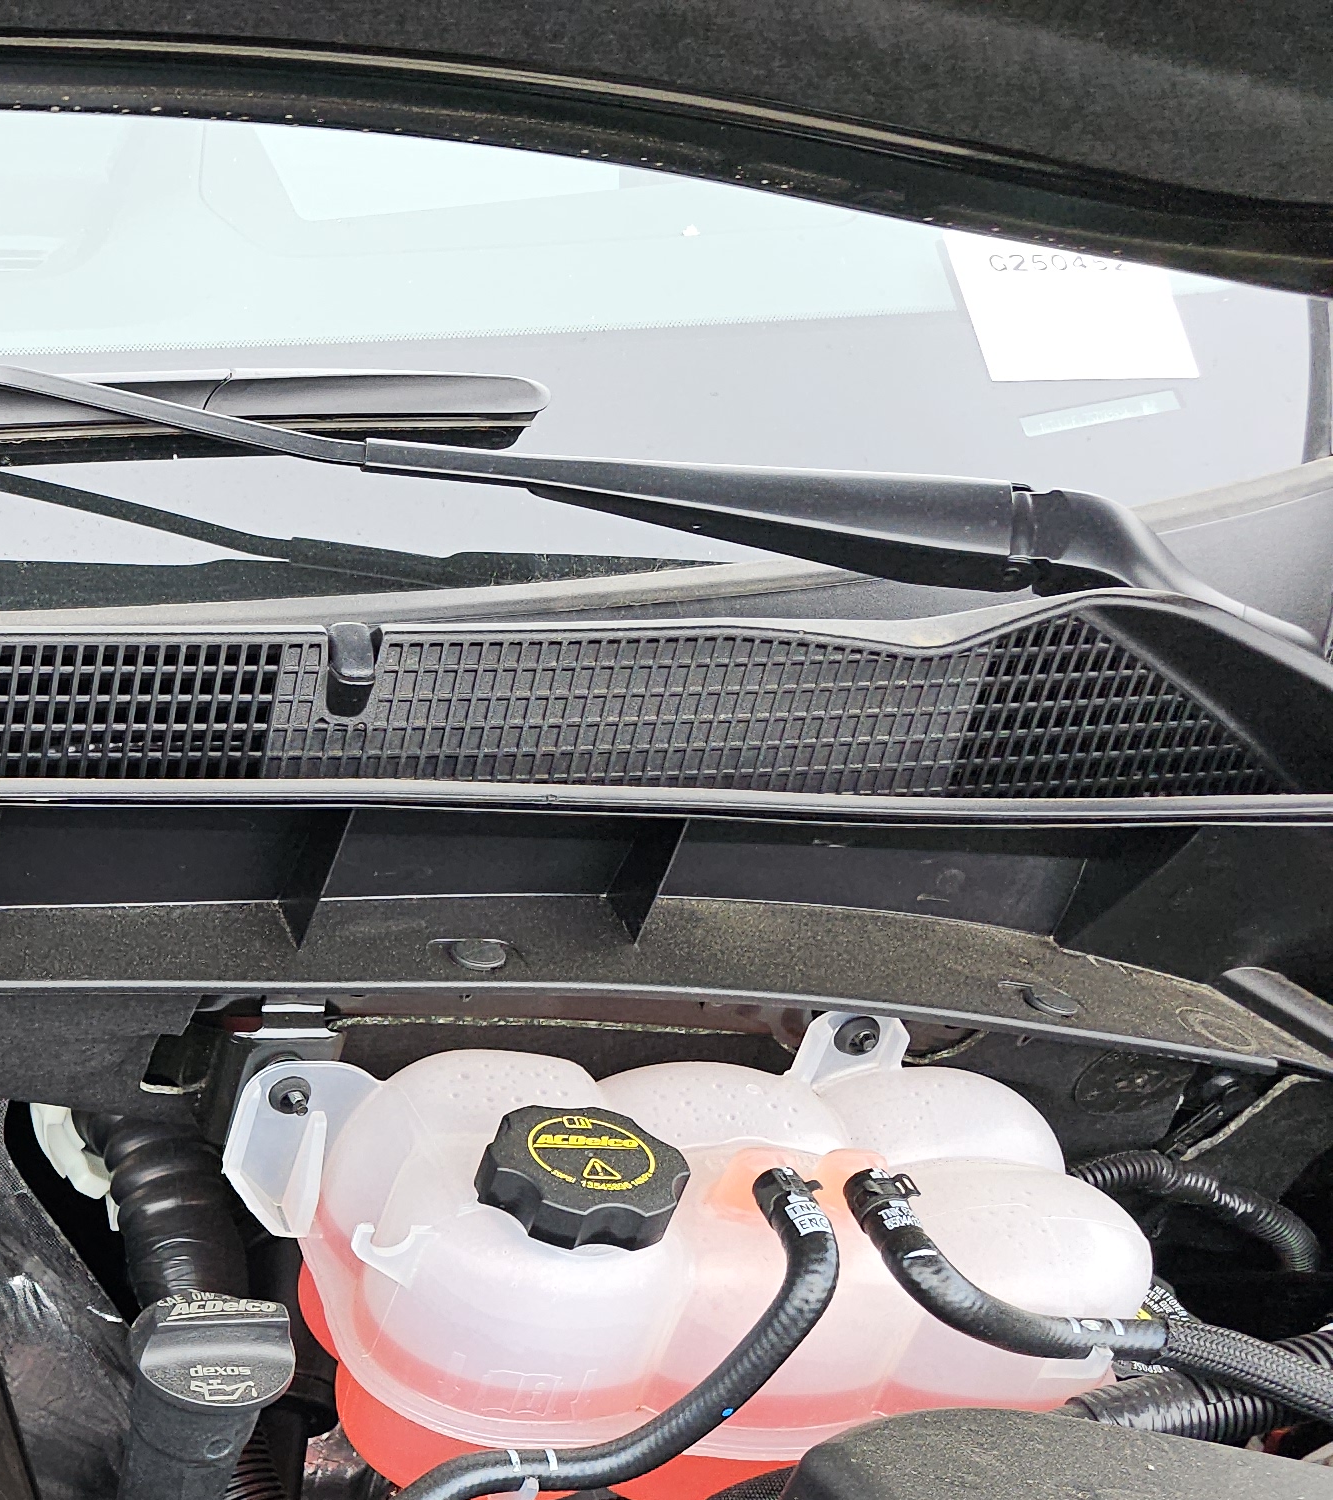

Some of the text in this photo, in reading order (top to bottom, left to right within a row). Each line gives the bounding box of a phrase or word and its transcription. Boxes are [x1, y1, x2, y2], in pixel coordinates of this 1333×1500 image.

[535, 1134, 639, 1147] ACDelco
[170, 1299, 277, 1316] ACDelco
[189, 1364, 252, 1378] dexos
